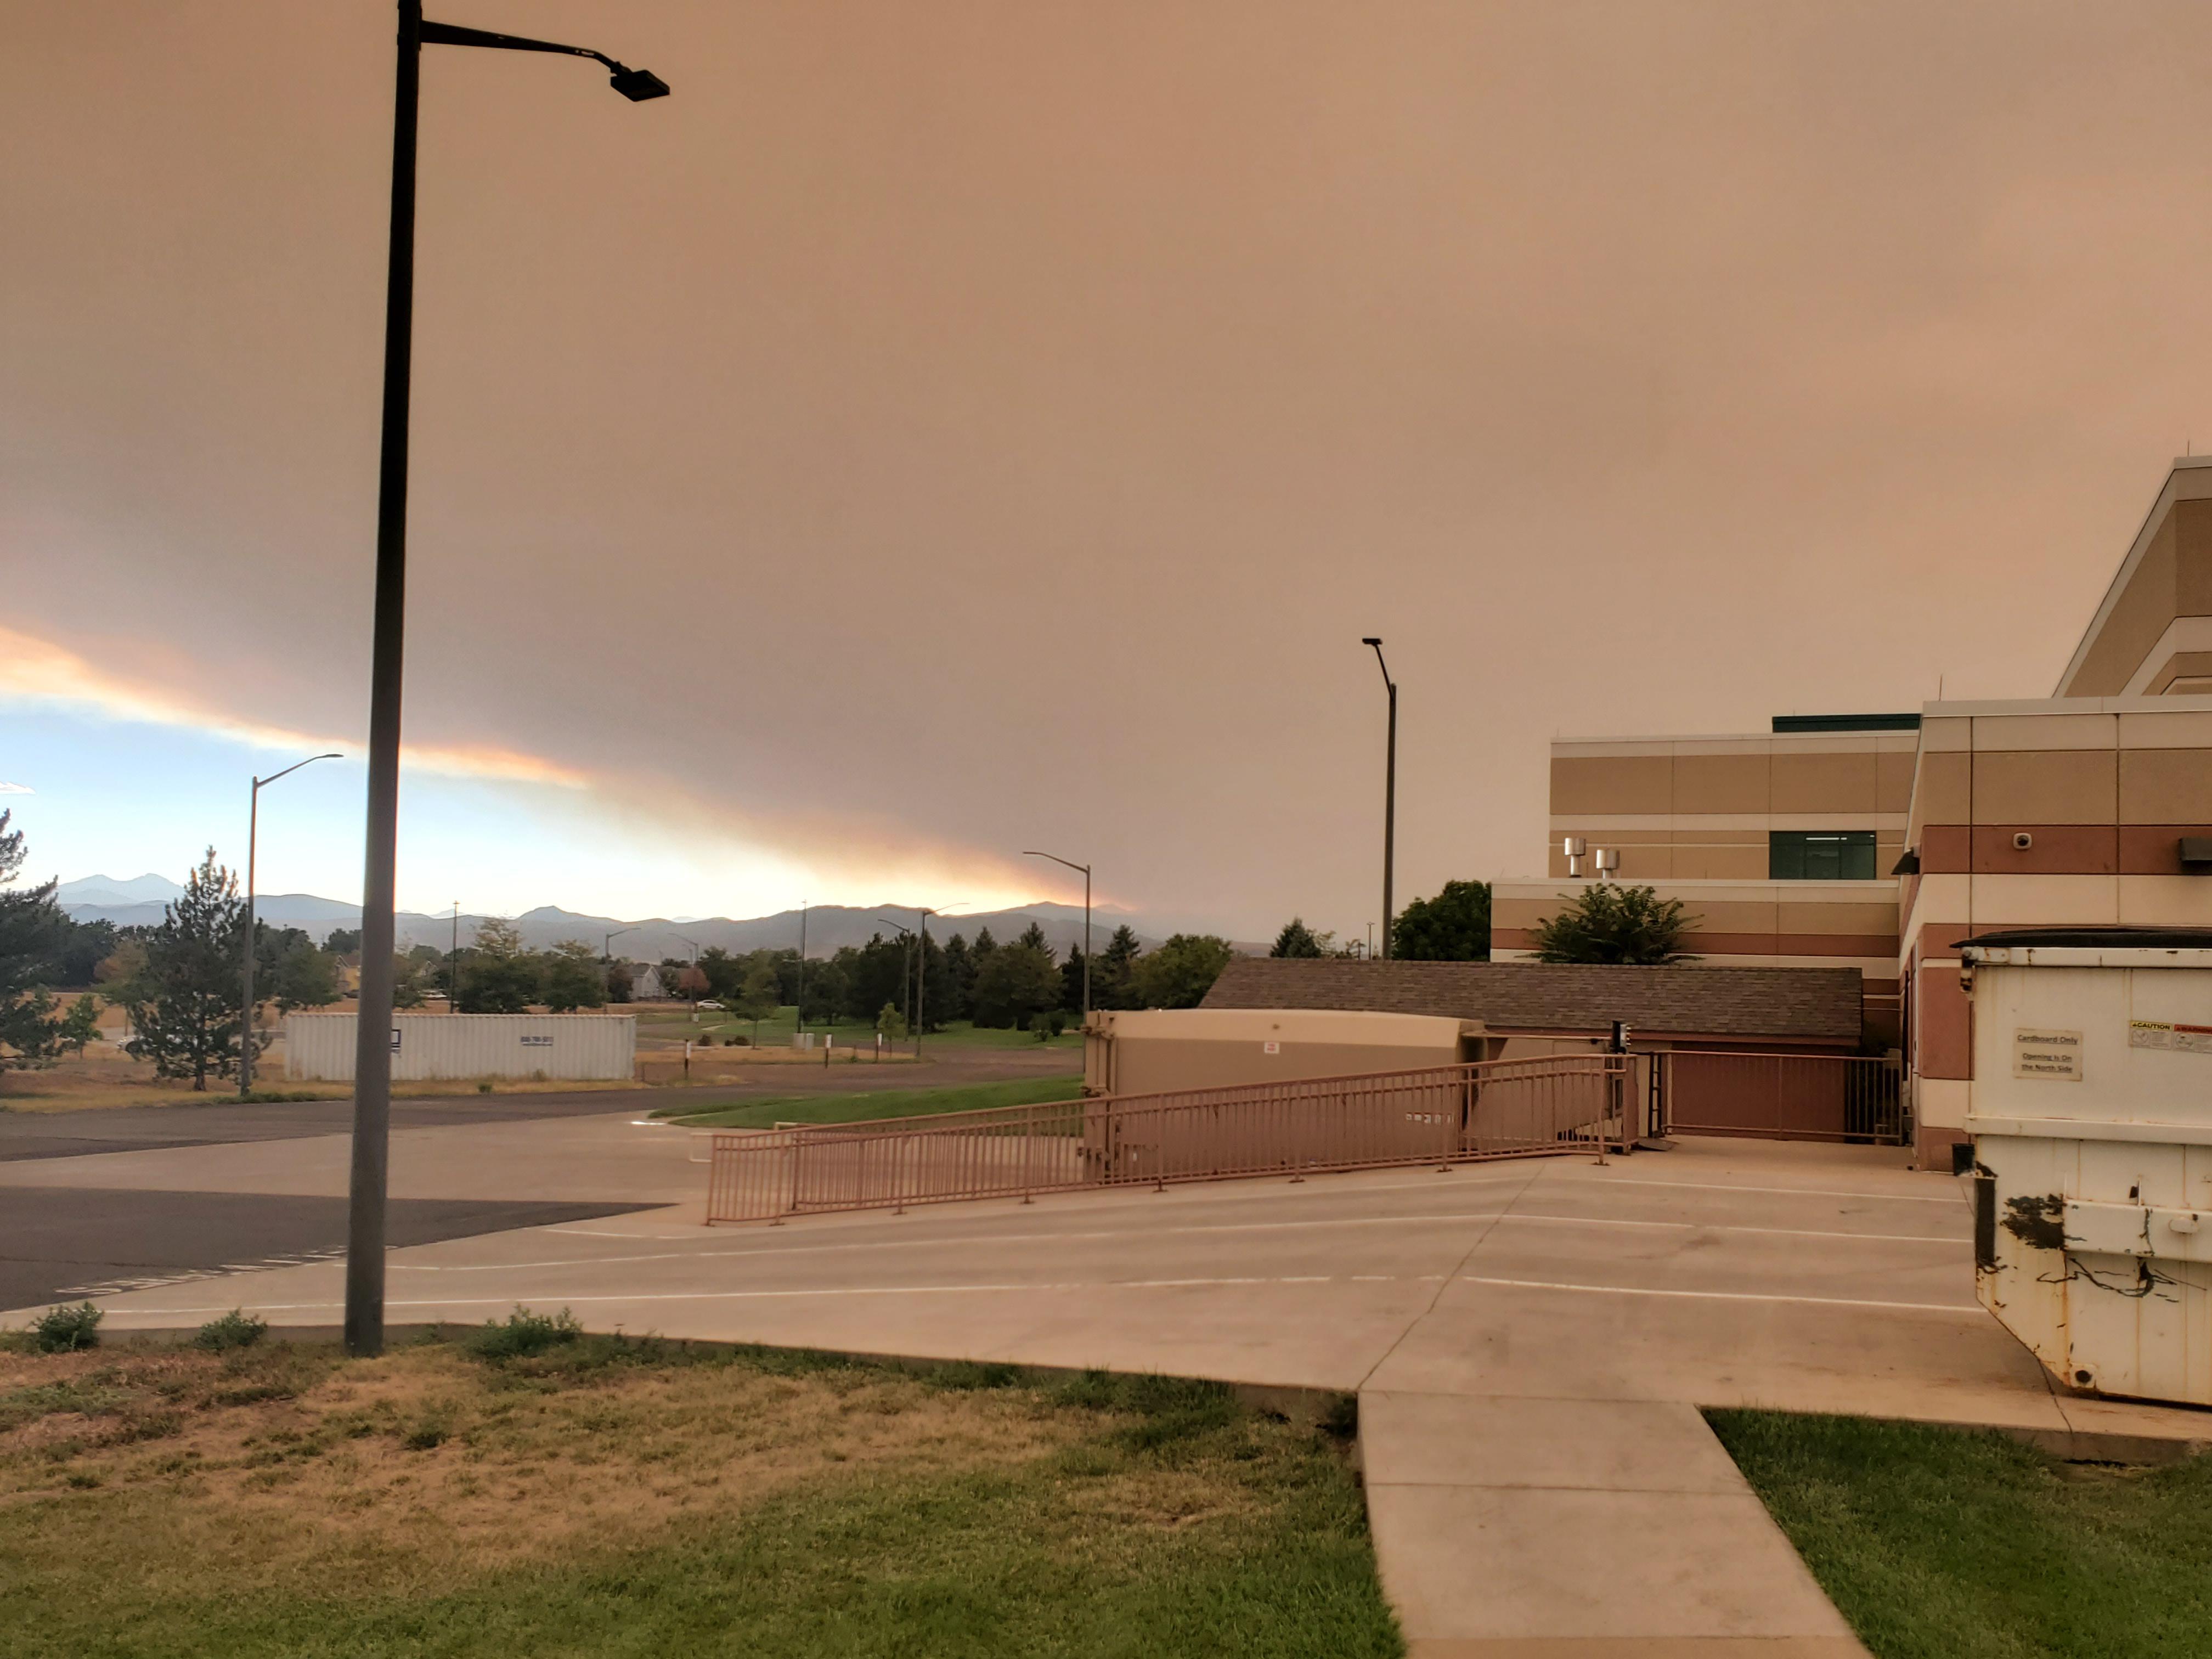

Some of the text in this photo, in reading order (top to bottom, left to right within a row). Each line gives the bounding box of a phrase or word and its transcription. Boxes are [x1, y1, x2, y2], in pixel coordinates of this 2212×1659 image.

[2018, 1035, 2078, 1045] Cardboard Only
[2023, 1053, 2052, 1061] Opening
